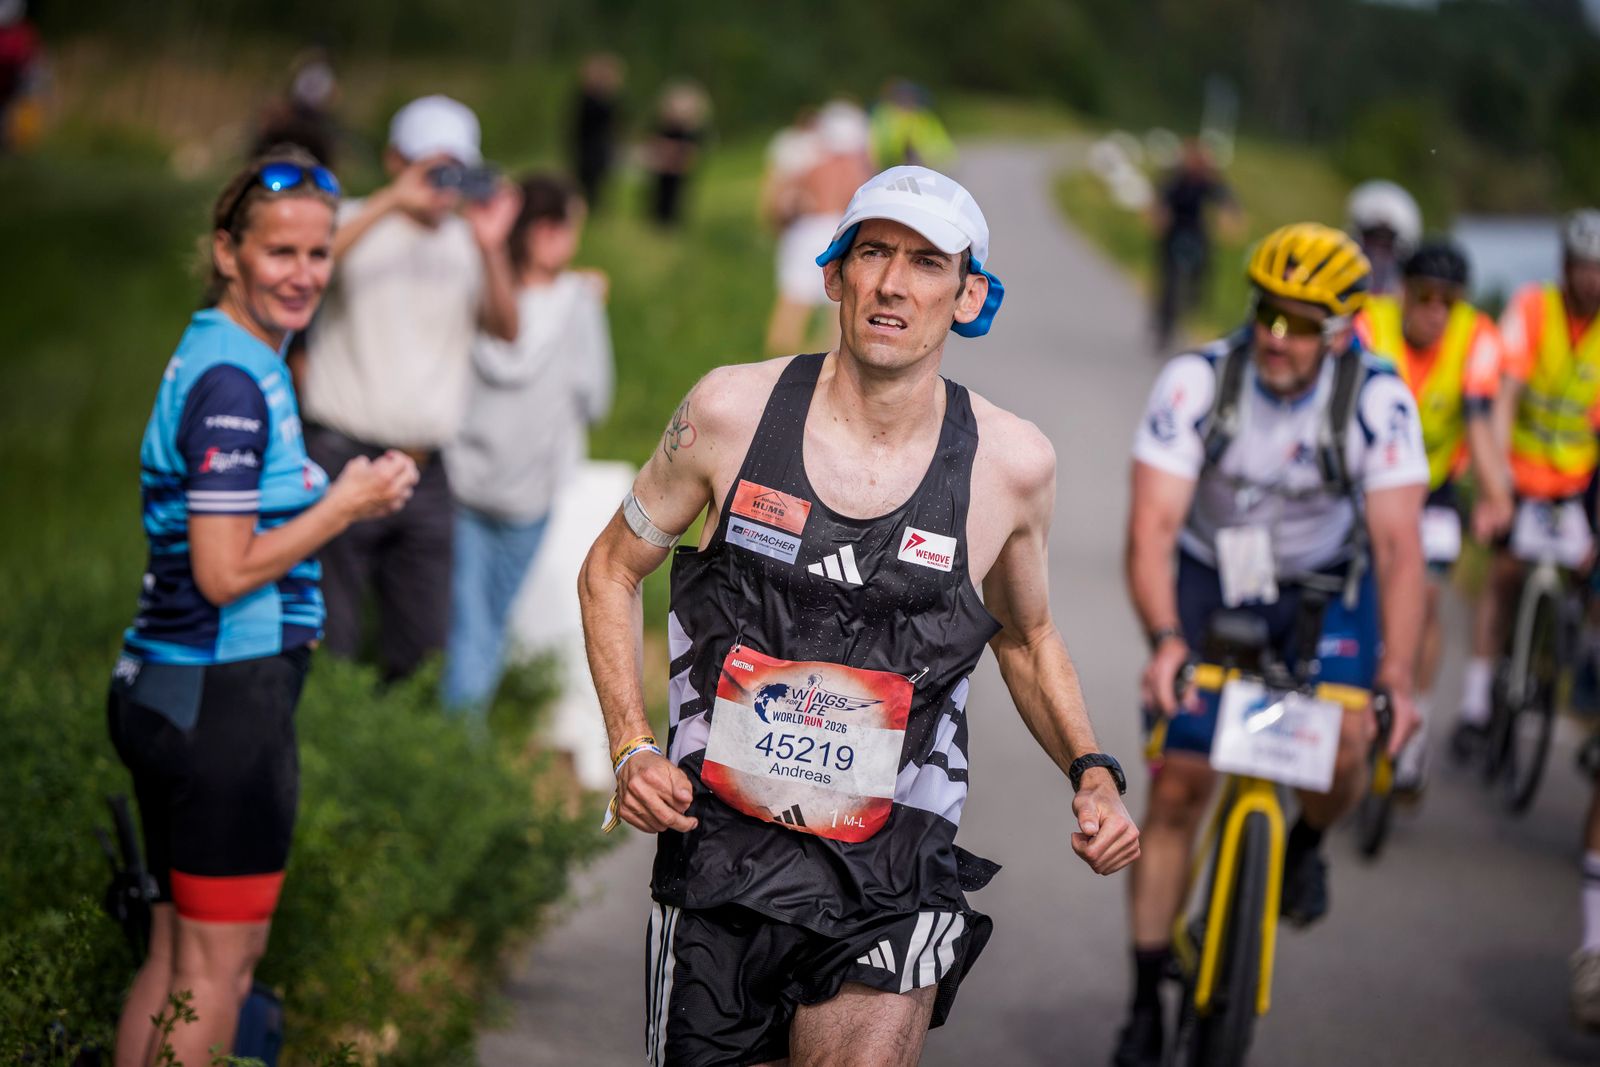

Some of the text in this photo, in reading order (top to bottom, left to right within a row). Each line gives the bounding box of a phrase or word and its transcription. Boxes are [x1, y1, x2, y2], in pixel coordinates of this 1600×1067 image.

[752, 500, 785, 516] HUMS
[743, 527, 796, 552] FITMACHER
[915, 548, 951, 565] WEMOVE
[731, 658, 754, 672] AUSTRIA
[785, 698, 799, 706] FOR
[792, 687, 848, 709] WINGS
[795, 699, 830, 717] LIFE
[824, 720, 848, 734] 2026
[755, 732, 855, 771] 45219
[768, 762, 831, 785] Andreas
[829, 808, 866, 828] 1 M-L
